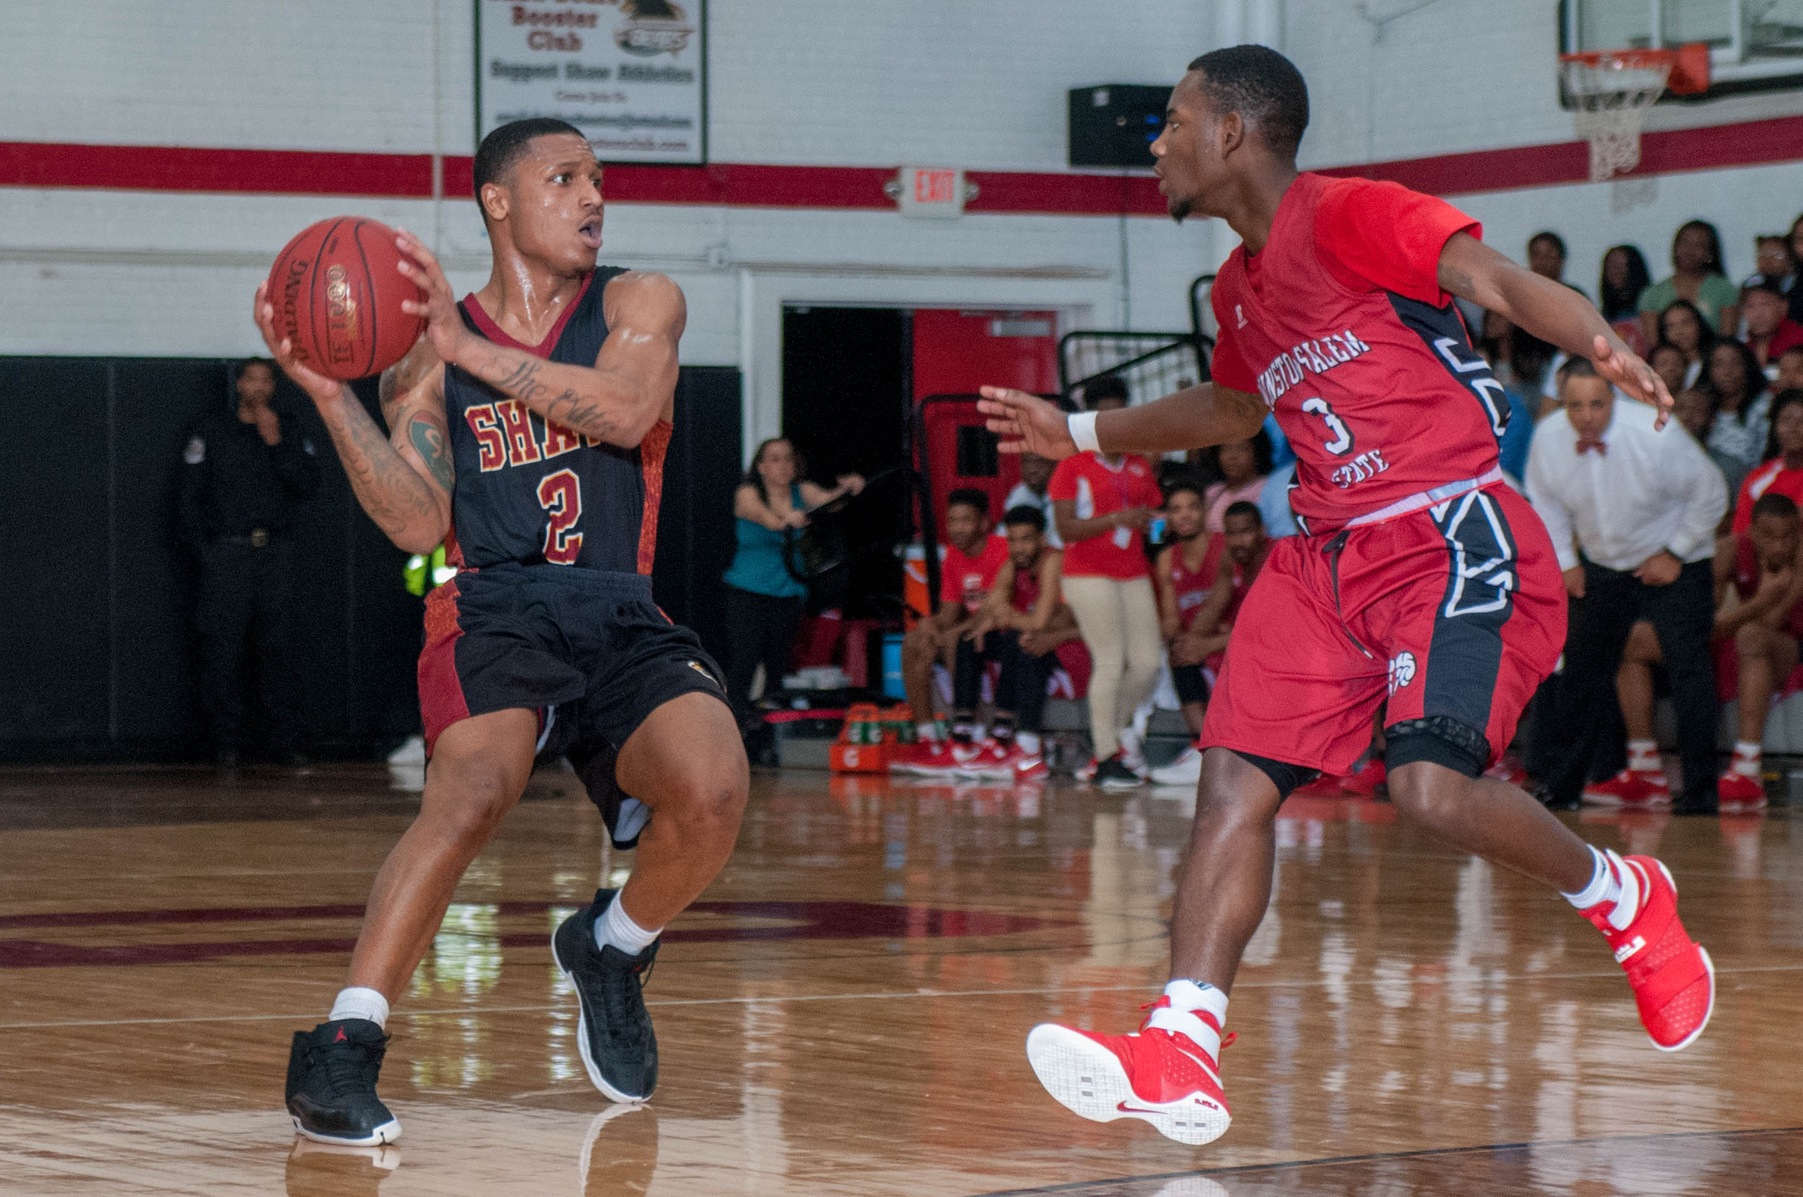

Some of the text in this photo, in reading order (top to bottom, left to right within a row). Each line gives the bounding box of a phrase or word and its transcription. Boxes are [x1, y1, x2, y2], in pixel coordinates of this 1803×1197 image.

[527, 30, 583, 51] Club
[914, 169, 955, 203] EXIT
[1302, 397, 1354, 456] 3
[1331, 449, 1390, 489] STATE
[537, 468, 583, 566] 2
